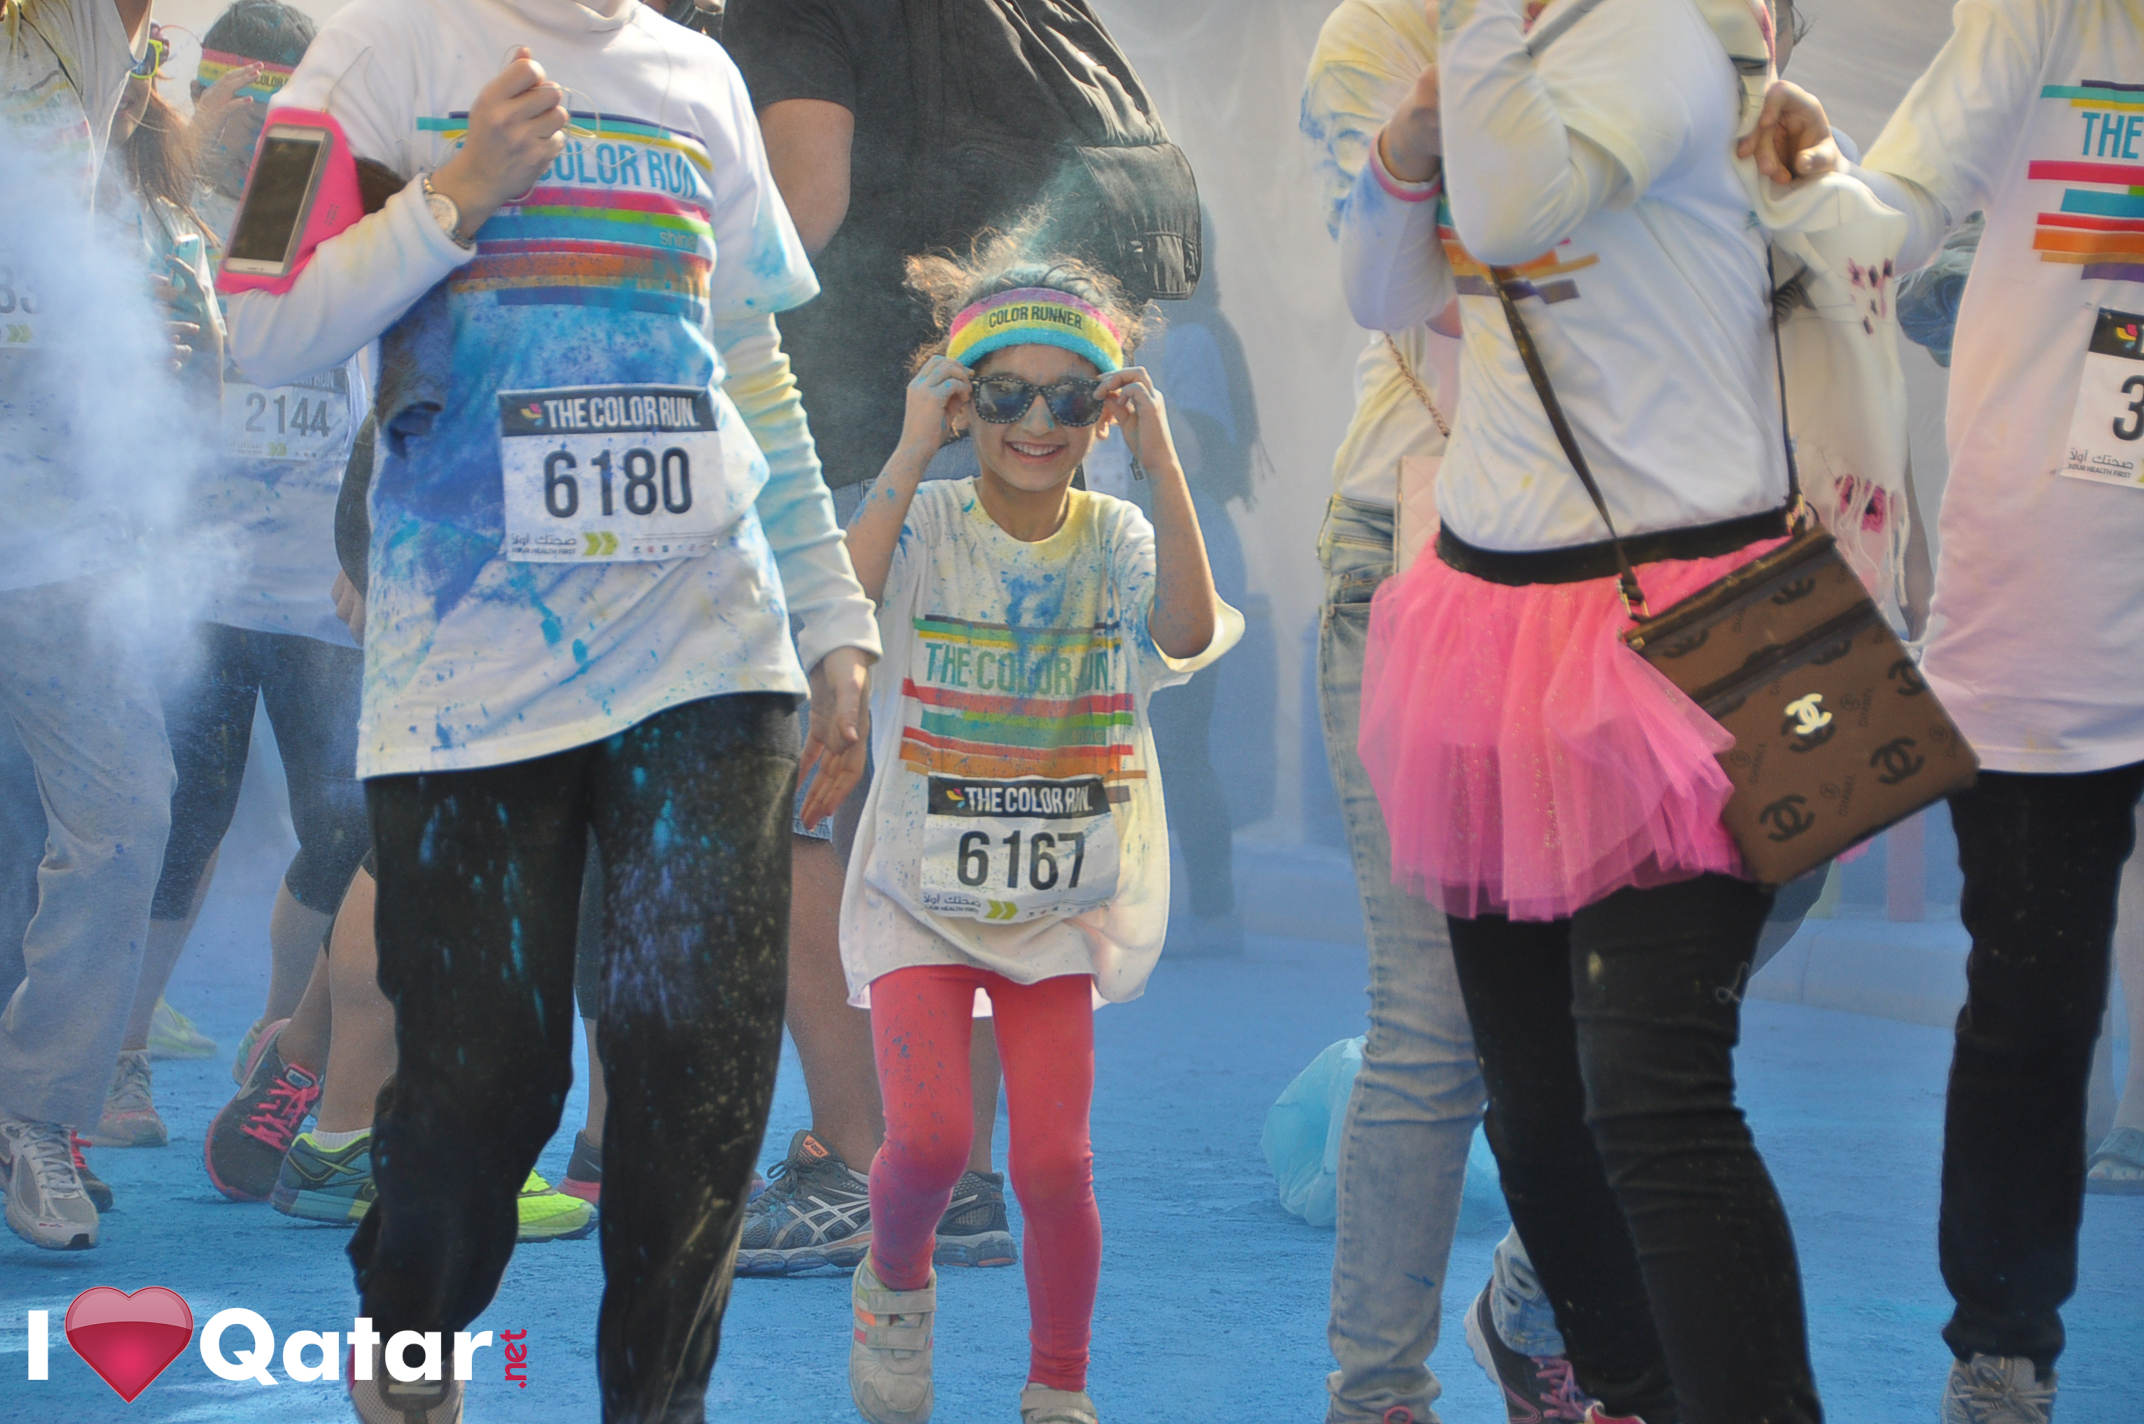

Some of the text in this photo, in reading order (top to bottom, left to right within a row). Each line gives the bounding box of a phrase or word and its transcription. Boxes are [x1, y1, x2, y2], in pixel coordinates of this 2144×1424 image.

[2081, 111, 2144, 159] THE
[538, 142, 698, 198] OLOR RUN
[989, 305, 1083, 330] COLOR RUNNER
[245, 391, 331, 438] 2144
[543, 398, 589, 428] THE
[589, 395, 659, 428] COLOR
[543, 446, 692, 518] 6180
[2086, 466, 2113, 475] HEALTH
[2112, 469, 2132, 478] FIRST
[925, 641, 1116, 696] THE COLOR UN.
[964, 786, 1003, 812] THE
[1005, 786, 1064, 814] COLOR
[957, 829, 1086, 890] 6167
